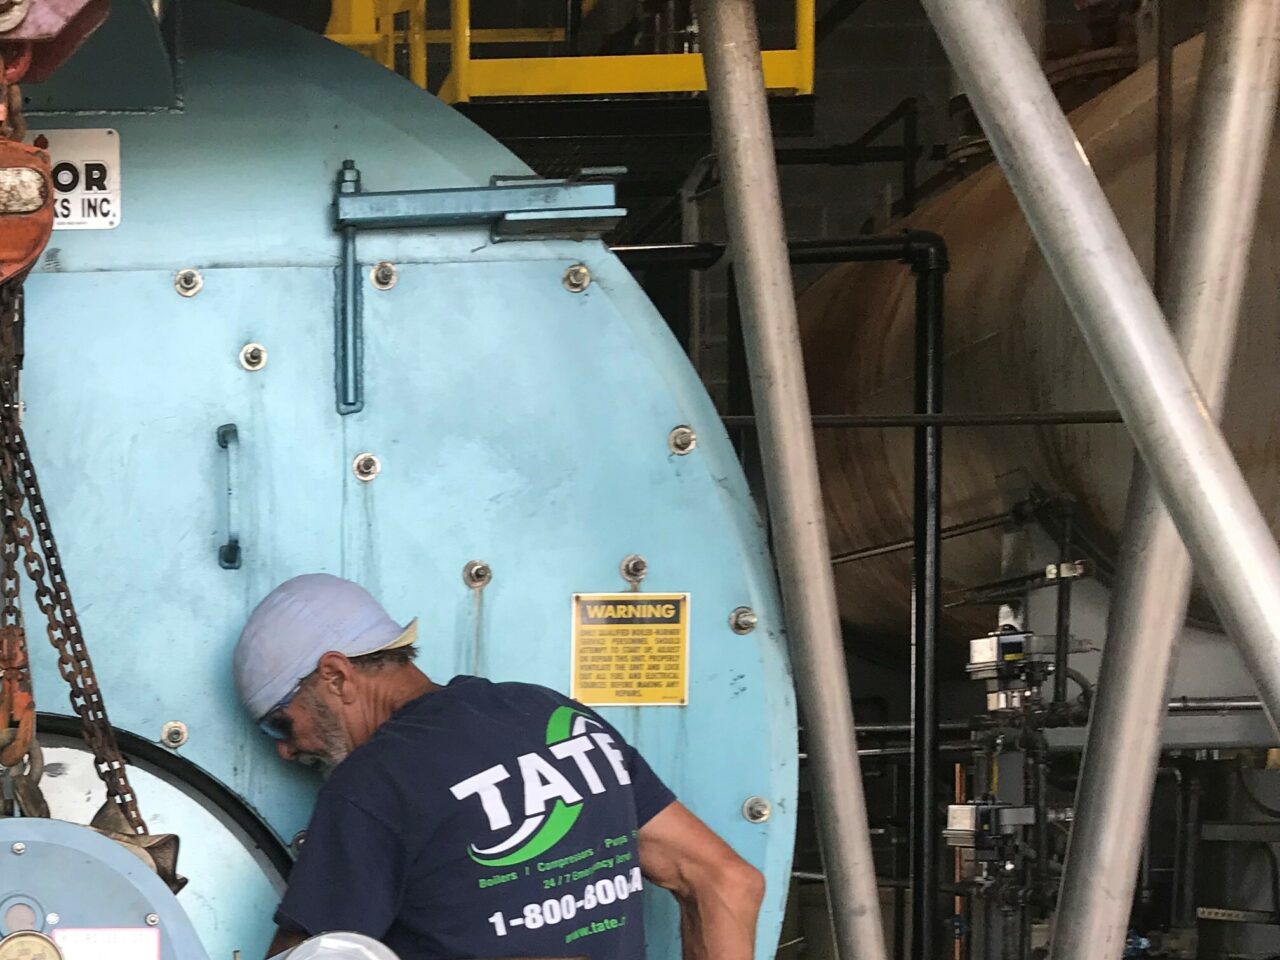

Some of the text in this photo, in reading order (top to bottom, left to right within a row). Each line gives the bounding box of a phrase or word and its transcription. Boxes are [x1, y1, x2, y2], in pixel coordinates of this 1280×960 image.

[81, 197, 116, 218] INC.
[586, 604, 676, 618] WARNING
[449, 732, 632, 831] TATE
[478, 871, 518, 889] Boilers
